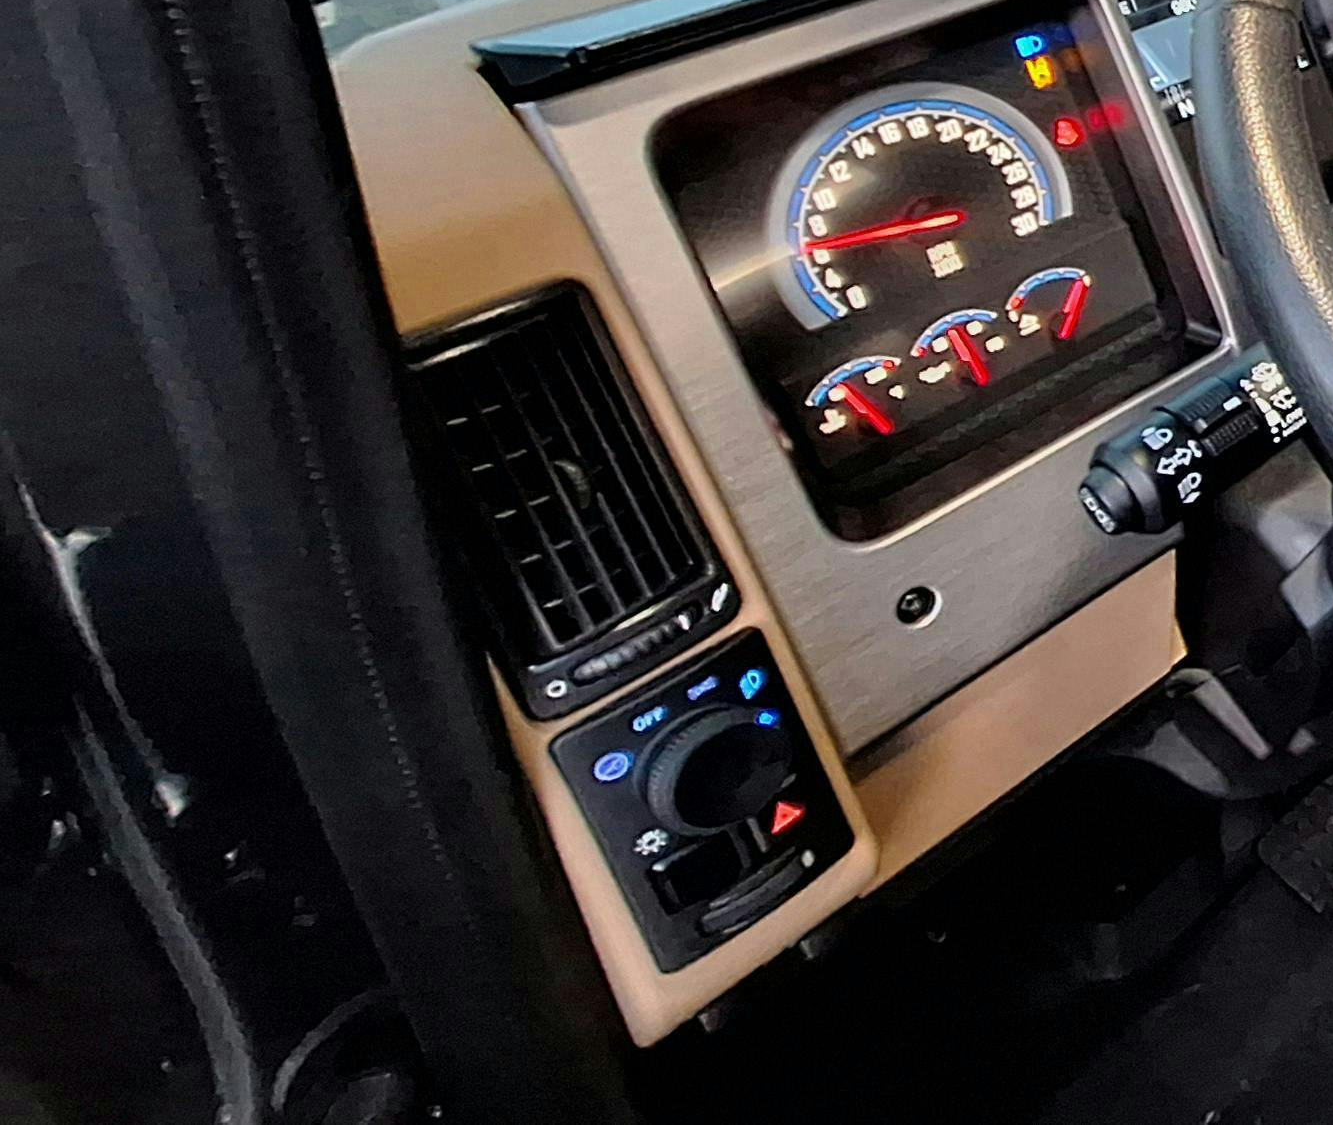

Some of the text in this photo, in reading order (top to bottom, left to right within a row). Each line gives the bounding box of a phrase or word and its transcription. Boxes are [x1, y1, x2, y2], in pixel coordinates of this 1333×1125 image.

[906, 116, 930, 139] 18
[935, 118, 962, 143] 20
[852, 136, 876, 159] 14
[828, 159, 851, 183] 12
[812, 187, 836, 210] 10
